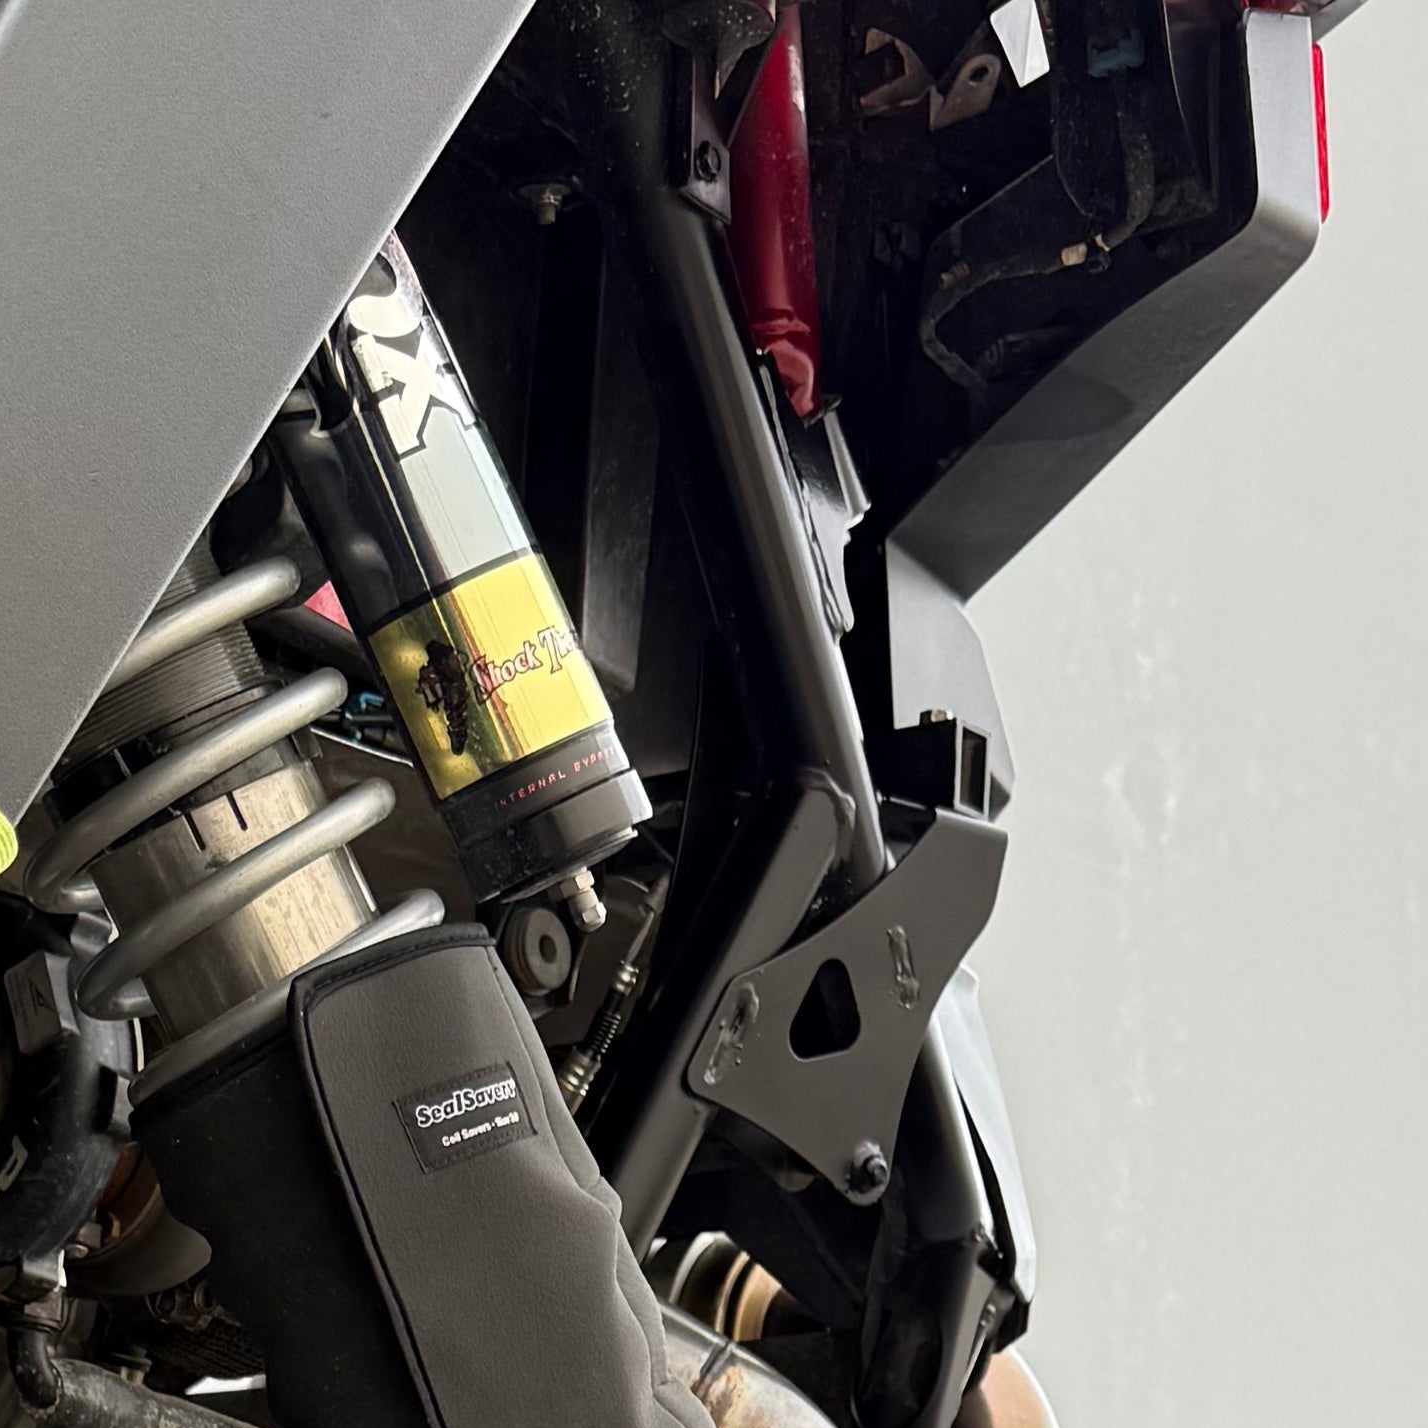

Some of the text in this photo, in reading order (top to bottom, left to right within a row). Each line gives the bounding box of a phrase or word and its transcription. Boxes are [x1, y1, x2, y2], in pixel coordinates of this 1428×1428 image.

[470, 640, 543, 705] Shock
[494, 770, 566, 811] INTERNAL
[416, 1077, 516, 1128] SealSavers
